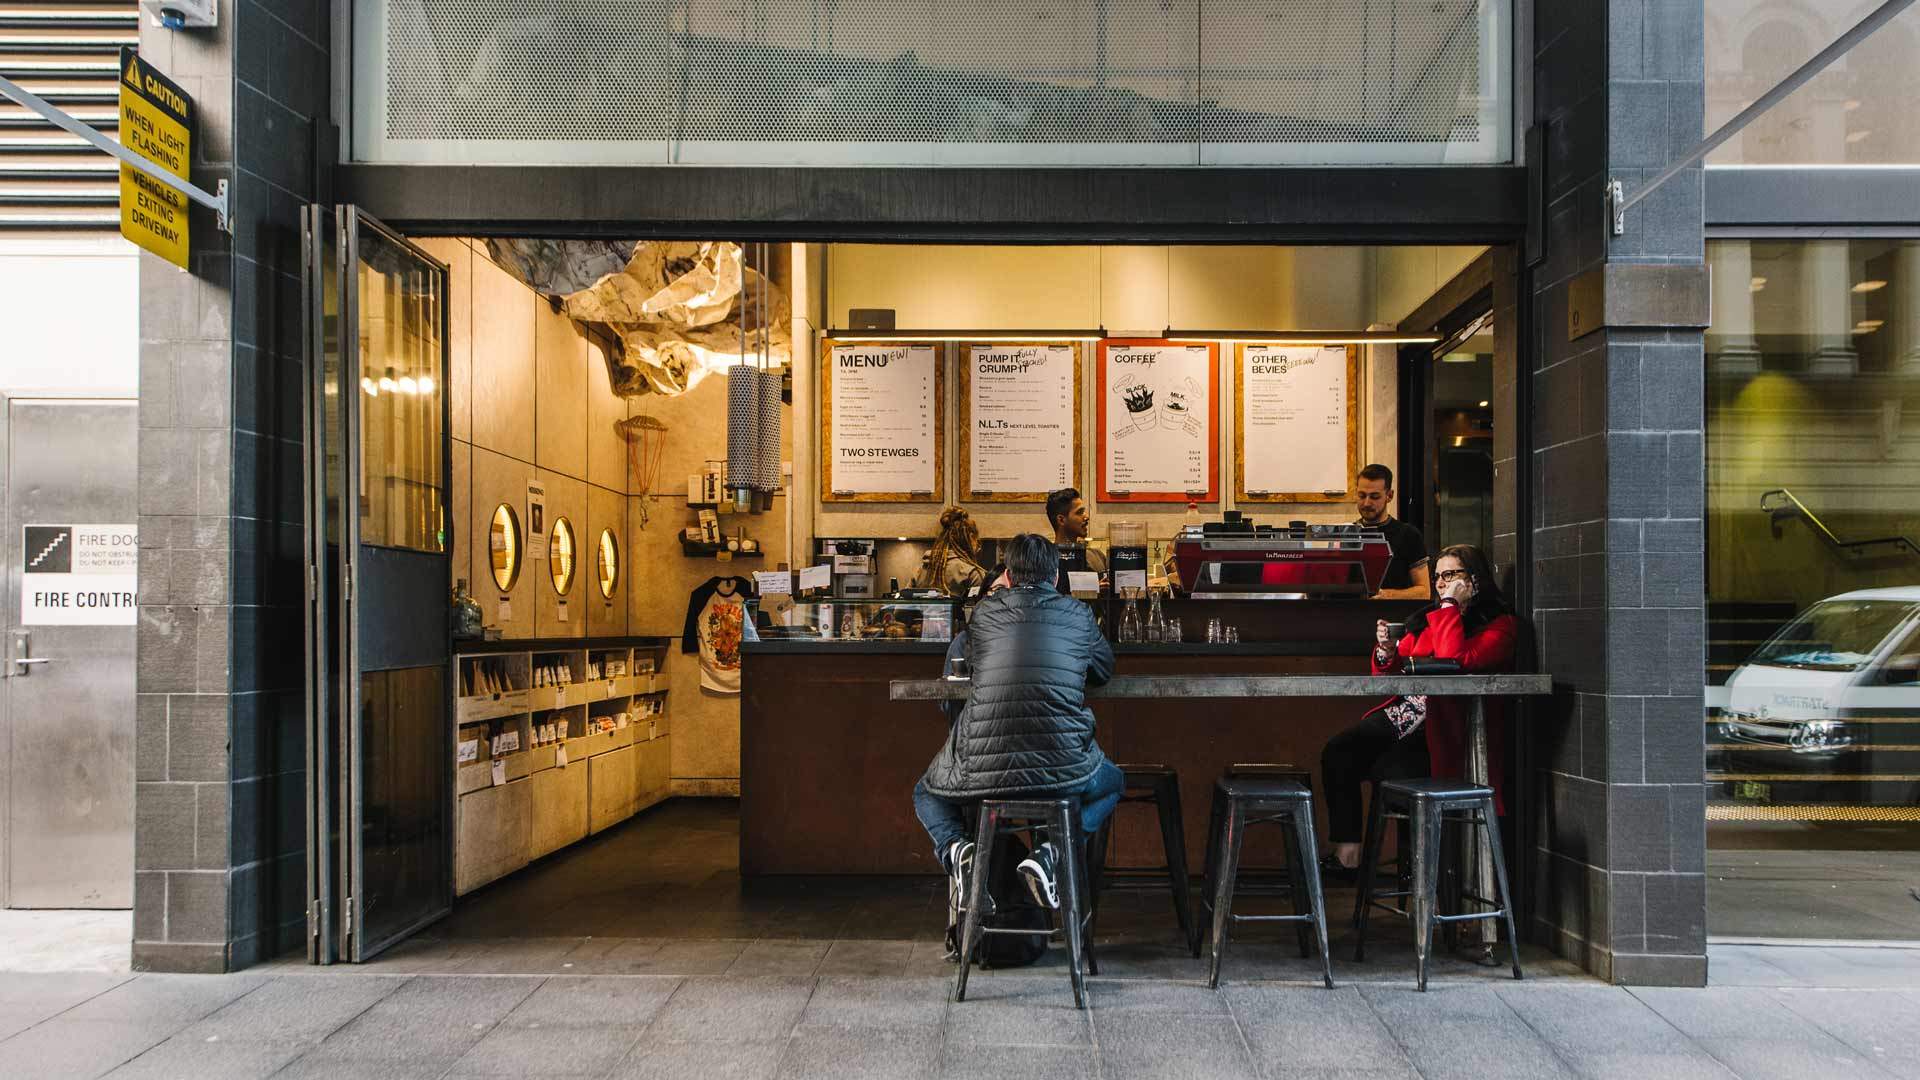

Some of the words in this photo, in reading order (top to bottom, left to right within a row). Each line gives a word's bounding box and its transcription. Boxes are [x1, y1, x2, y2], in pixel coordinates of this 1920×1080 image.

[145, 75, 188, 118] CAUTION
[126, 106, 155, 137] WHEN
[158, 128, 186, 156] LIGHT
[132, 131, 180, 171] FLASHING
[132, 170, 180, 206] VEHICLES
[137, 191, 175, 224] EXITING
[131, 209, 180, 245] DRIVEWAY
[840, 354, 887, 367] MENU
[979, 354, 1008, 363] PUMP
[1010, 354, 1019, 363] IT
[1114, 354, 1156, 363] COFFEE
[1252, 355, 1287, 364] OTHER
[979, 365, 1018, 373] CRUMP
[1019, 365, 1028, 373] IT
[1252, 365, 1287, 374] BEVIES
[1126, 384, 1147, 393] BLACK
[1170, 391, 1185, 400] MILK
[978, 420, 1008, 429] N.L.Ts
[840, 448, 866, 457] TWO
[867, 447, 919, 457] STEWGES
[79, 534, 107, 546] FIRE
[35, 592, 69, 608] FIRE
